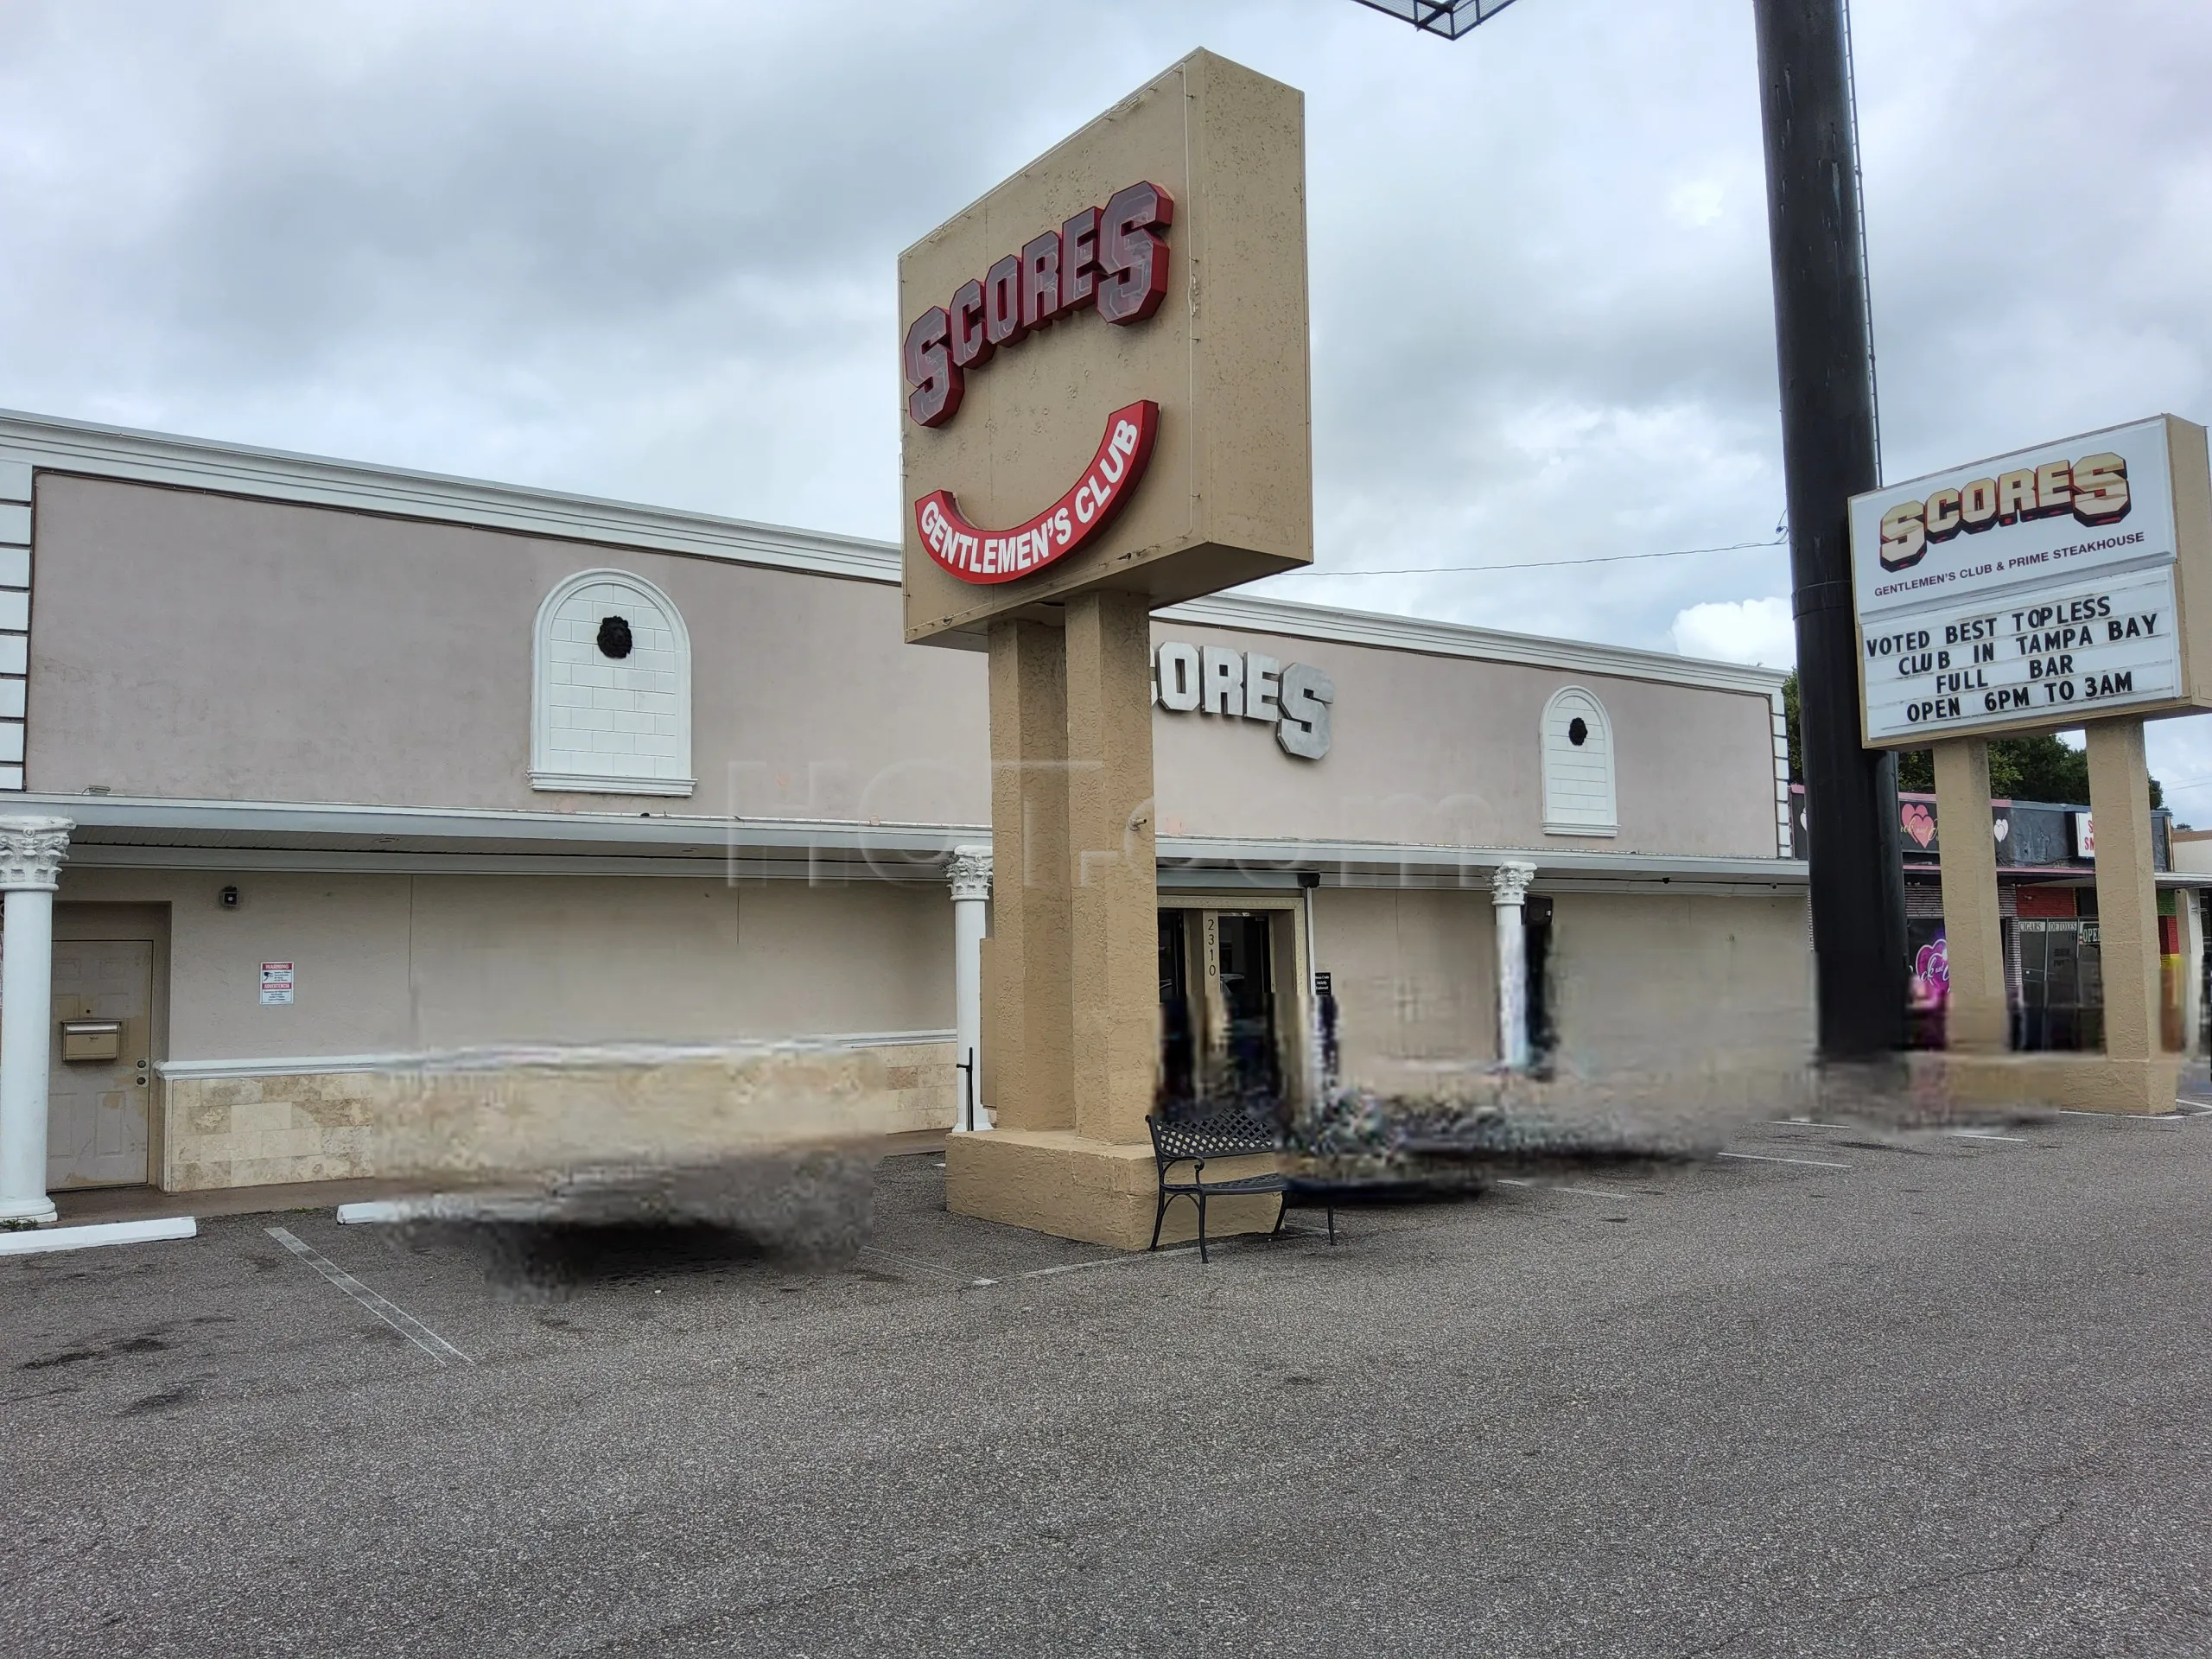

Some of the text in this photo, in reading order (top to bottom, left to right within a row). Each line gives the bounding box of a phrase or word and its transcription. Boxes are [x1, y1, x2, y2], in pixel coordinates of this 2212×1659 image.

[905, 181, 1174, 428] SCORES
[920, 419, 1139, 574] GENTLEMEN'S CLUB
[1879, 452, 2132, 573] SCORES
[1874, 531, 2145, 597] GENTLEMEN'S CLUB & PRIME STEAKHOUSE
[1866, 595, 2111, 658] VOTED BEST TOPLESS
[1898, 613, 2158, 676] CLUB IN TAMPA BAY
[1150, 641, 1336, 760] ORES
[1907, 671, 2133, 722] OPEN 6PM TO 3AM
[1936, 654, 2074, 694] FULL BAR
[1208, 918, 1217, 976] 2310
[2018, 922, 2076, 931] CIGARS DETOXES
[2082, 928, 2101, 943] OPE
